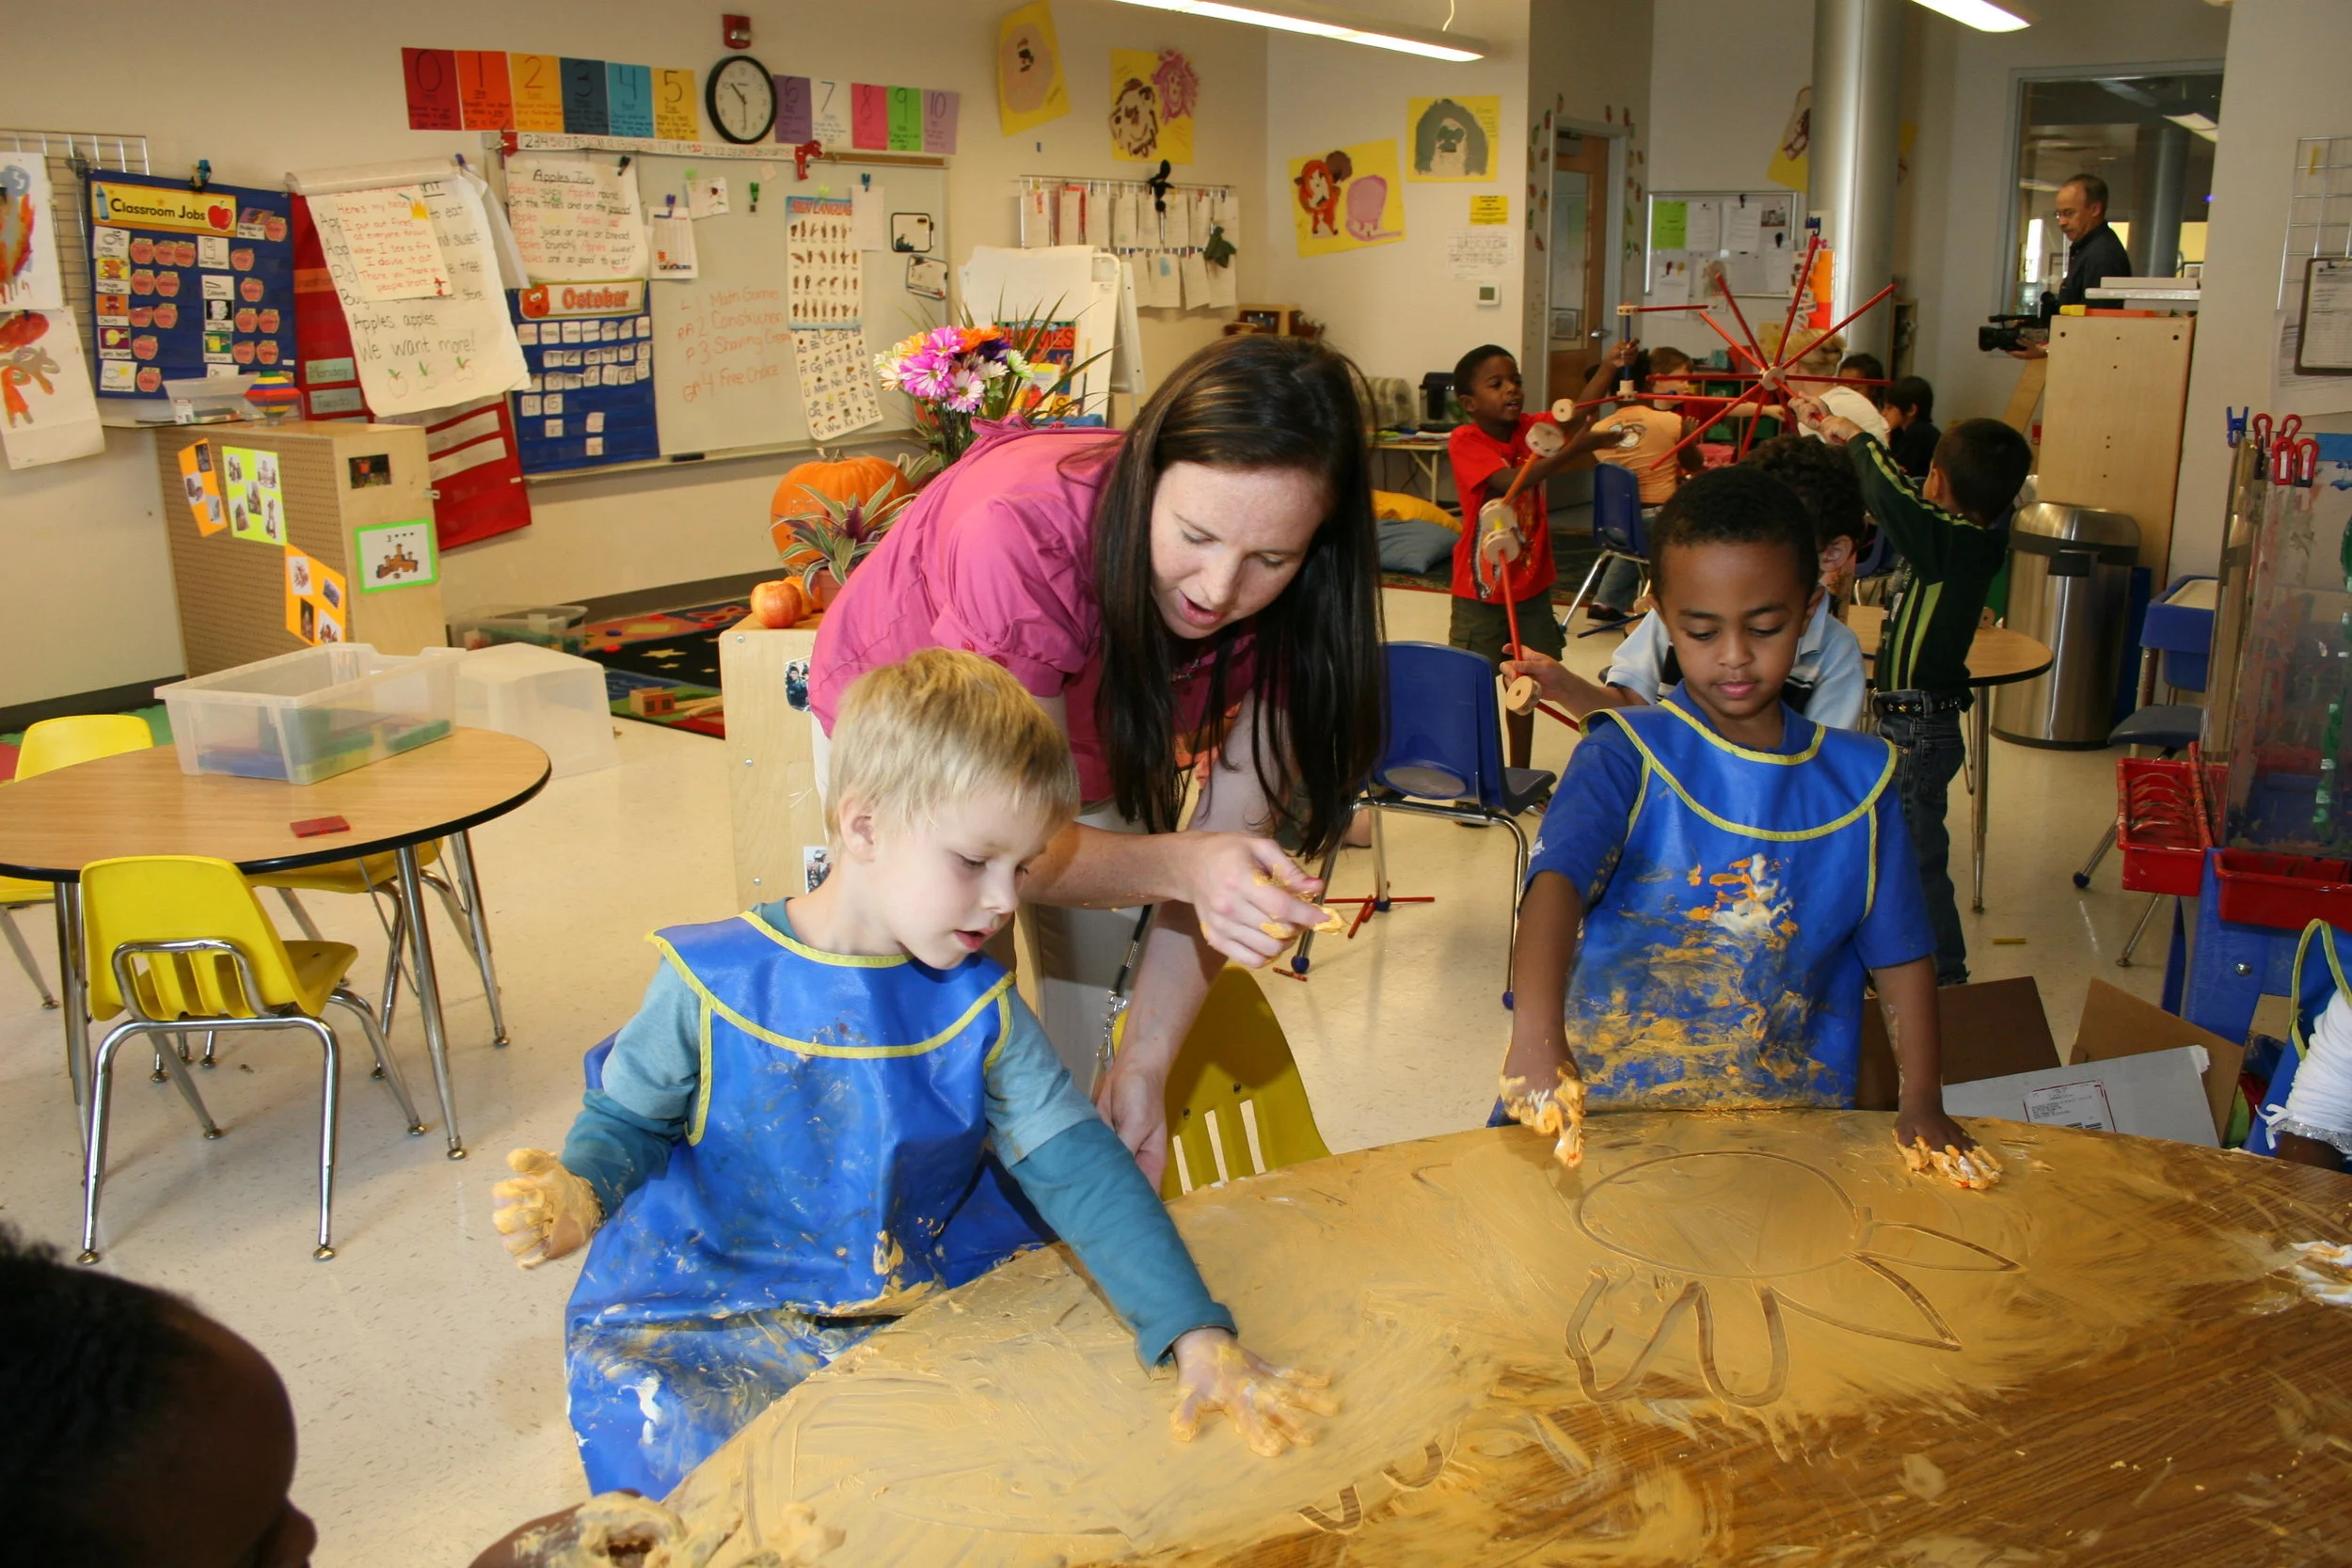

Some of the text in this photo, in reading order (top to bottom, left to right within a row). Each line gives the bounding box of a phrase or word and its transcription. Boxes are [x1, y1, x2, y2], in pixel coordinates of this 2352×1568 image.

[415, 49, 443, 92] 0
[523, 55, 544, 89] 2
[575, 61, 594, 98] 3
[619, 65, 638, 101] 4
[663, 70, 683, 103] 5
[785, 77, 799, 104] 6
[820, 81, 835, 113] 7
[860, 85, 872, 120] 8
[895, 87, 908, 124] 9
[930, 92, 946, 119] 10
[523, 135, 532, 148] 2
[534, 135, 541, 148] 3
[541, 136, 548, 148] 4
[110, 198, 206, 223] Classroom Jobs
[562, 286, 629, 310] October
[357, 329, 477, 363] We want more!
[698, 340, 711, 365] 3
